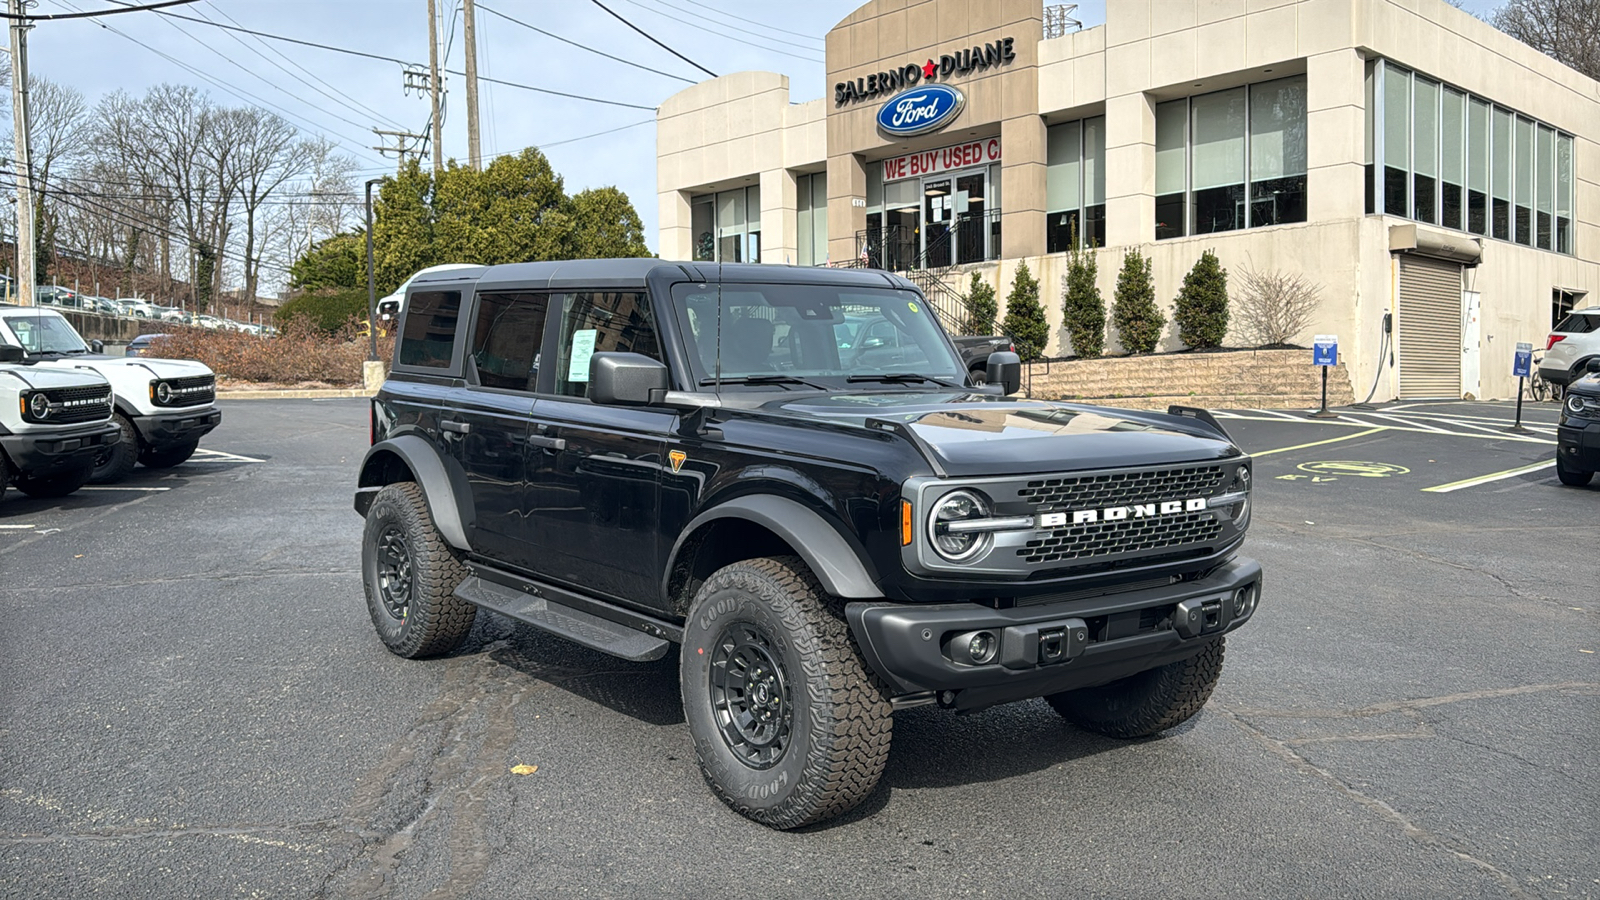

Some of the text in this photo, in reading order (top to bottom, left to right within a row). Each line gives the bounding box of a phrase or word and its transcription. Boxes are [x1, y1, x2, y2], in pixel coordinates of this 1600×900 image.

[834, 37, 1016, 102] SALERNO DUANE
[892, 95, 939, 126] Ford
[885, 157, 907, 180] WE
[910, 151, 939, 175] BUY
[943, 141, 983, 169] USED
[1041, 498, 1207, 528] BRONCO
